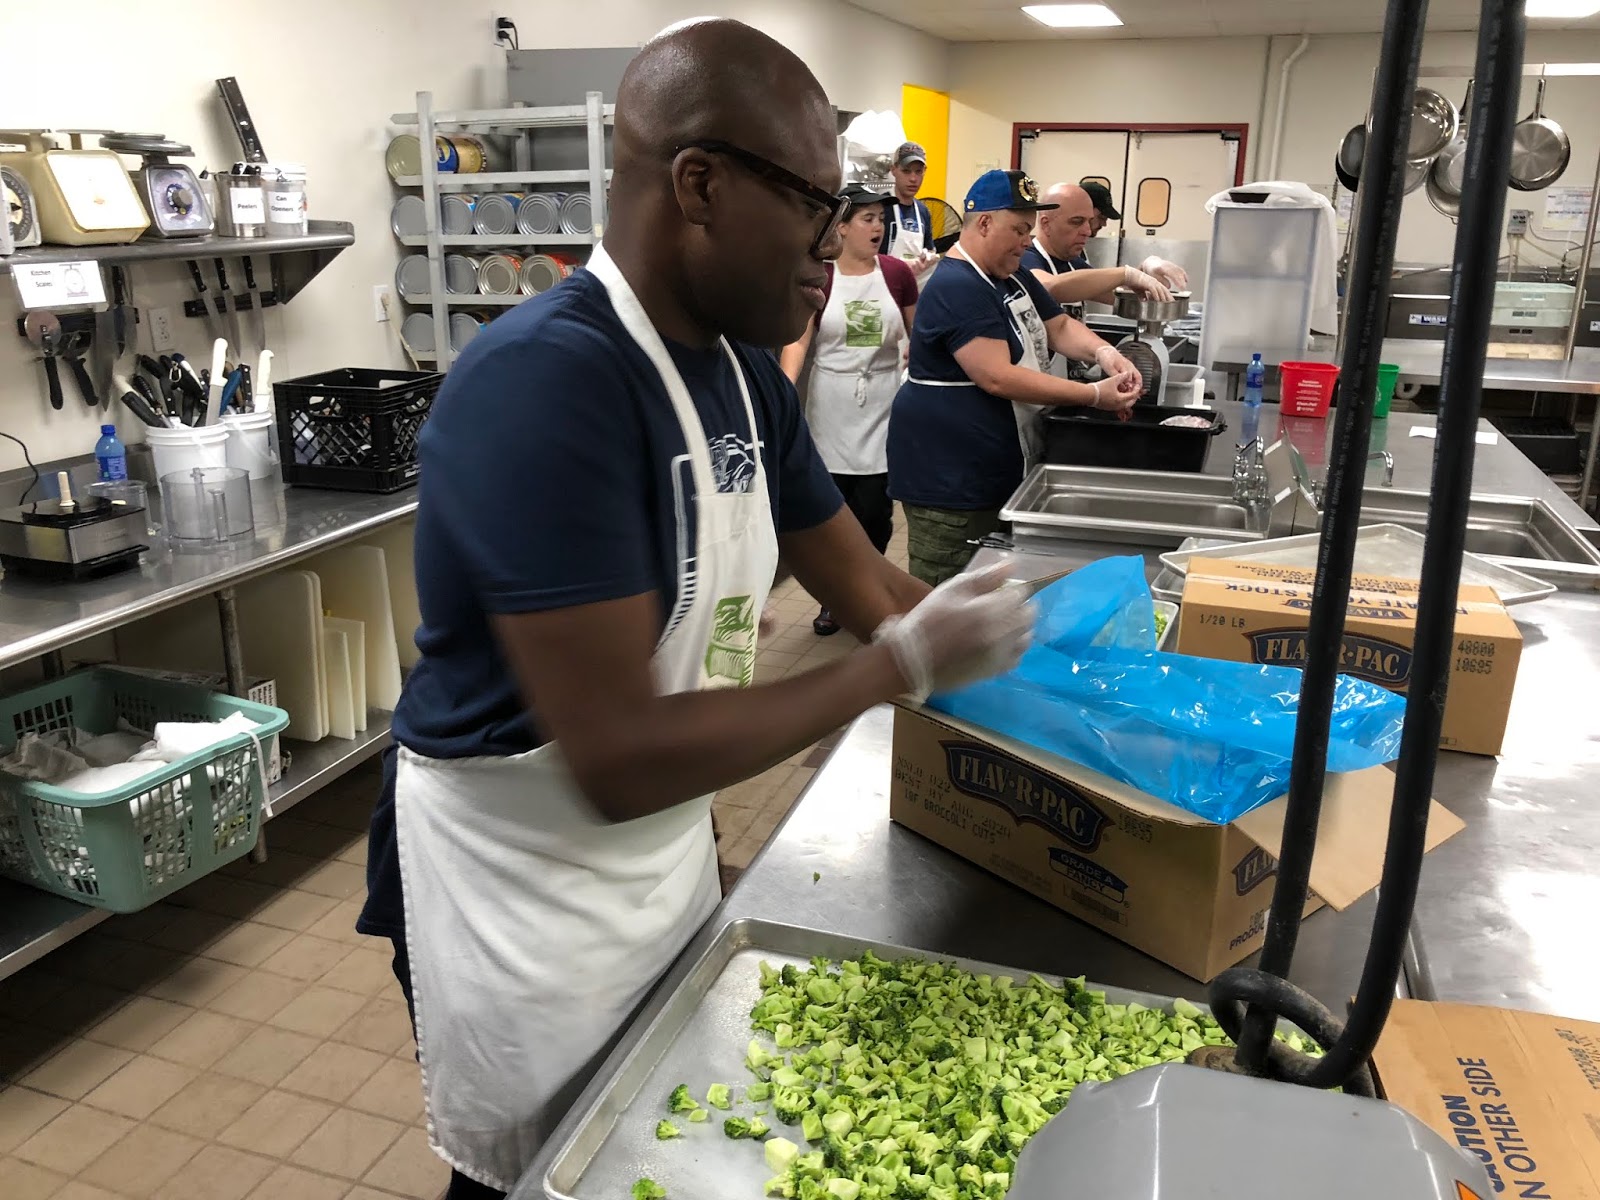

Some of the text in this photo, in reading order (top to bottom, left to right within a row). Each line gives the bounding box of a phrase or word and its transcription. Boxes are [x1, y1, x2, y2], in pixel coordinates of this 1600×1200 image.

[1224, 583, 1298, 598] STOCK
[1231, 617, 1246, 628] LB
[924, 798, 967, 829] BROCCOLI
[972, 824, 996, 844] CUTS
[1060, 854, 1101, 877] GRADE
[1066, 866, 1105, 892] FANCY
[1229, 921, 1265, 950] PRODUC
[1456, 1056, 1502, 1097] SIDE
[1480, 1103, 1537, 1173] OTHER
